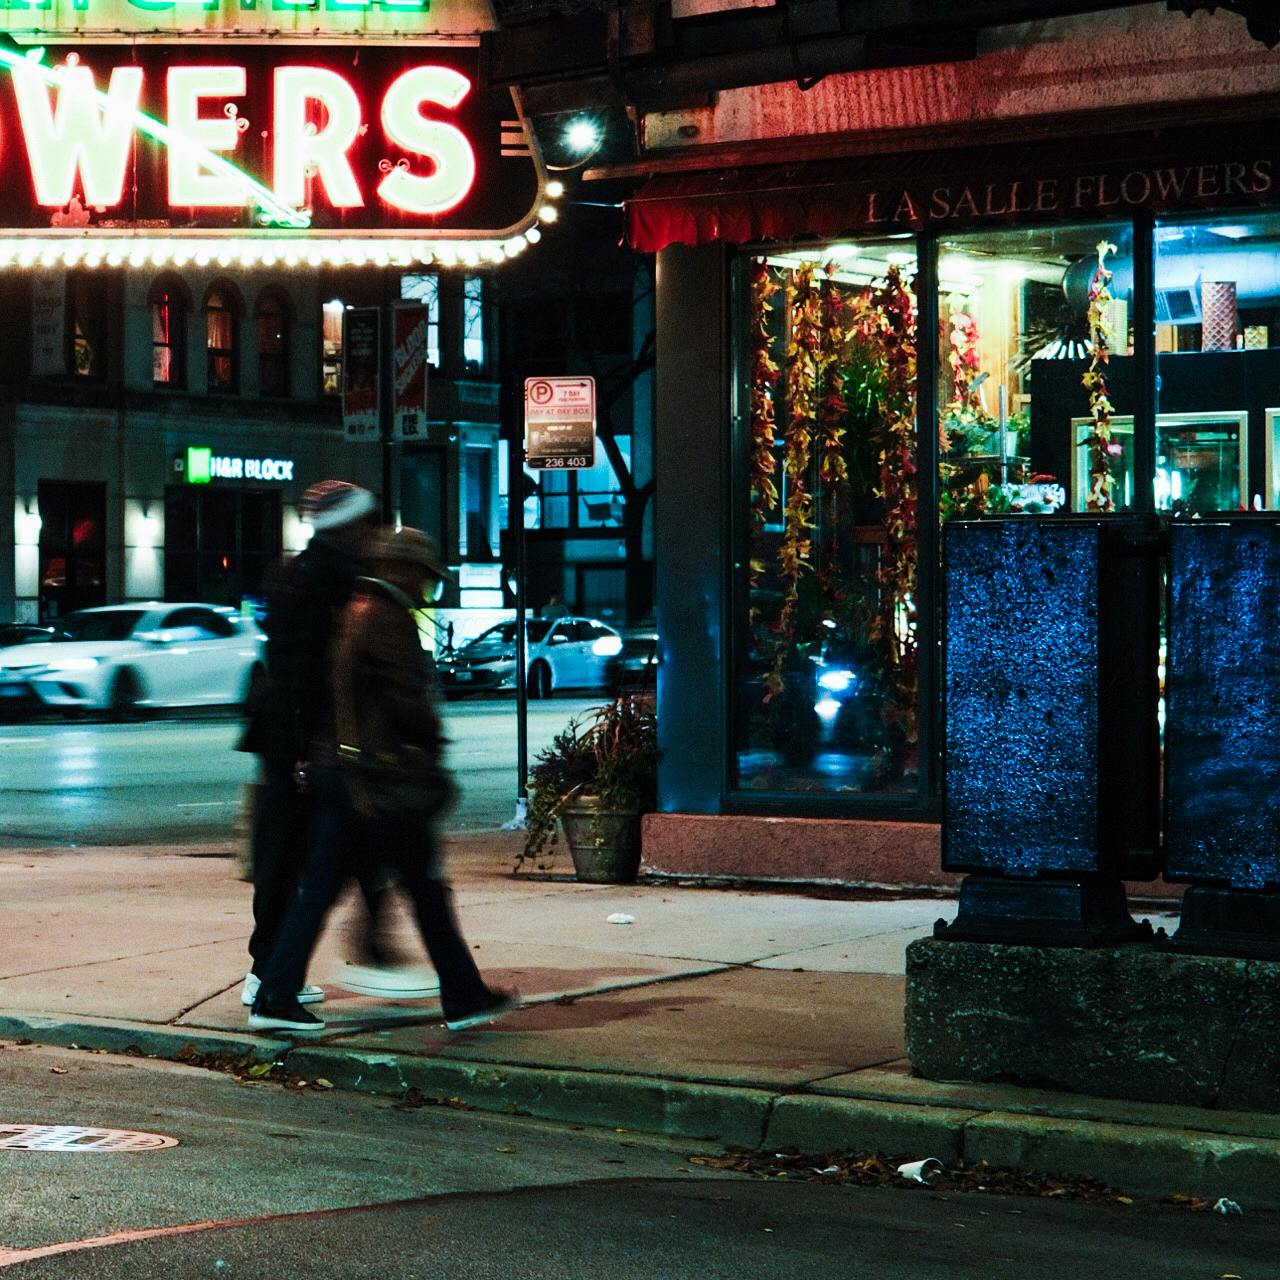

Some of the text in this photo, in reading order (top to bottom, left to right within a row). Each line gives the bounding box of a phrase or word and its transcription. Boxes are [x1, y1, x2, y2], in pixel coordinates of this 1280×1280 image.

[865, 159, 1273, 224] LA SALLE FLOWERS
[536, 386, 548, 400] P
[210, 457, 294, 480] H&R BLOCK
[545, 457, 586, 468] 236 403
